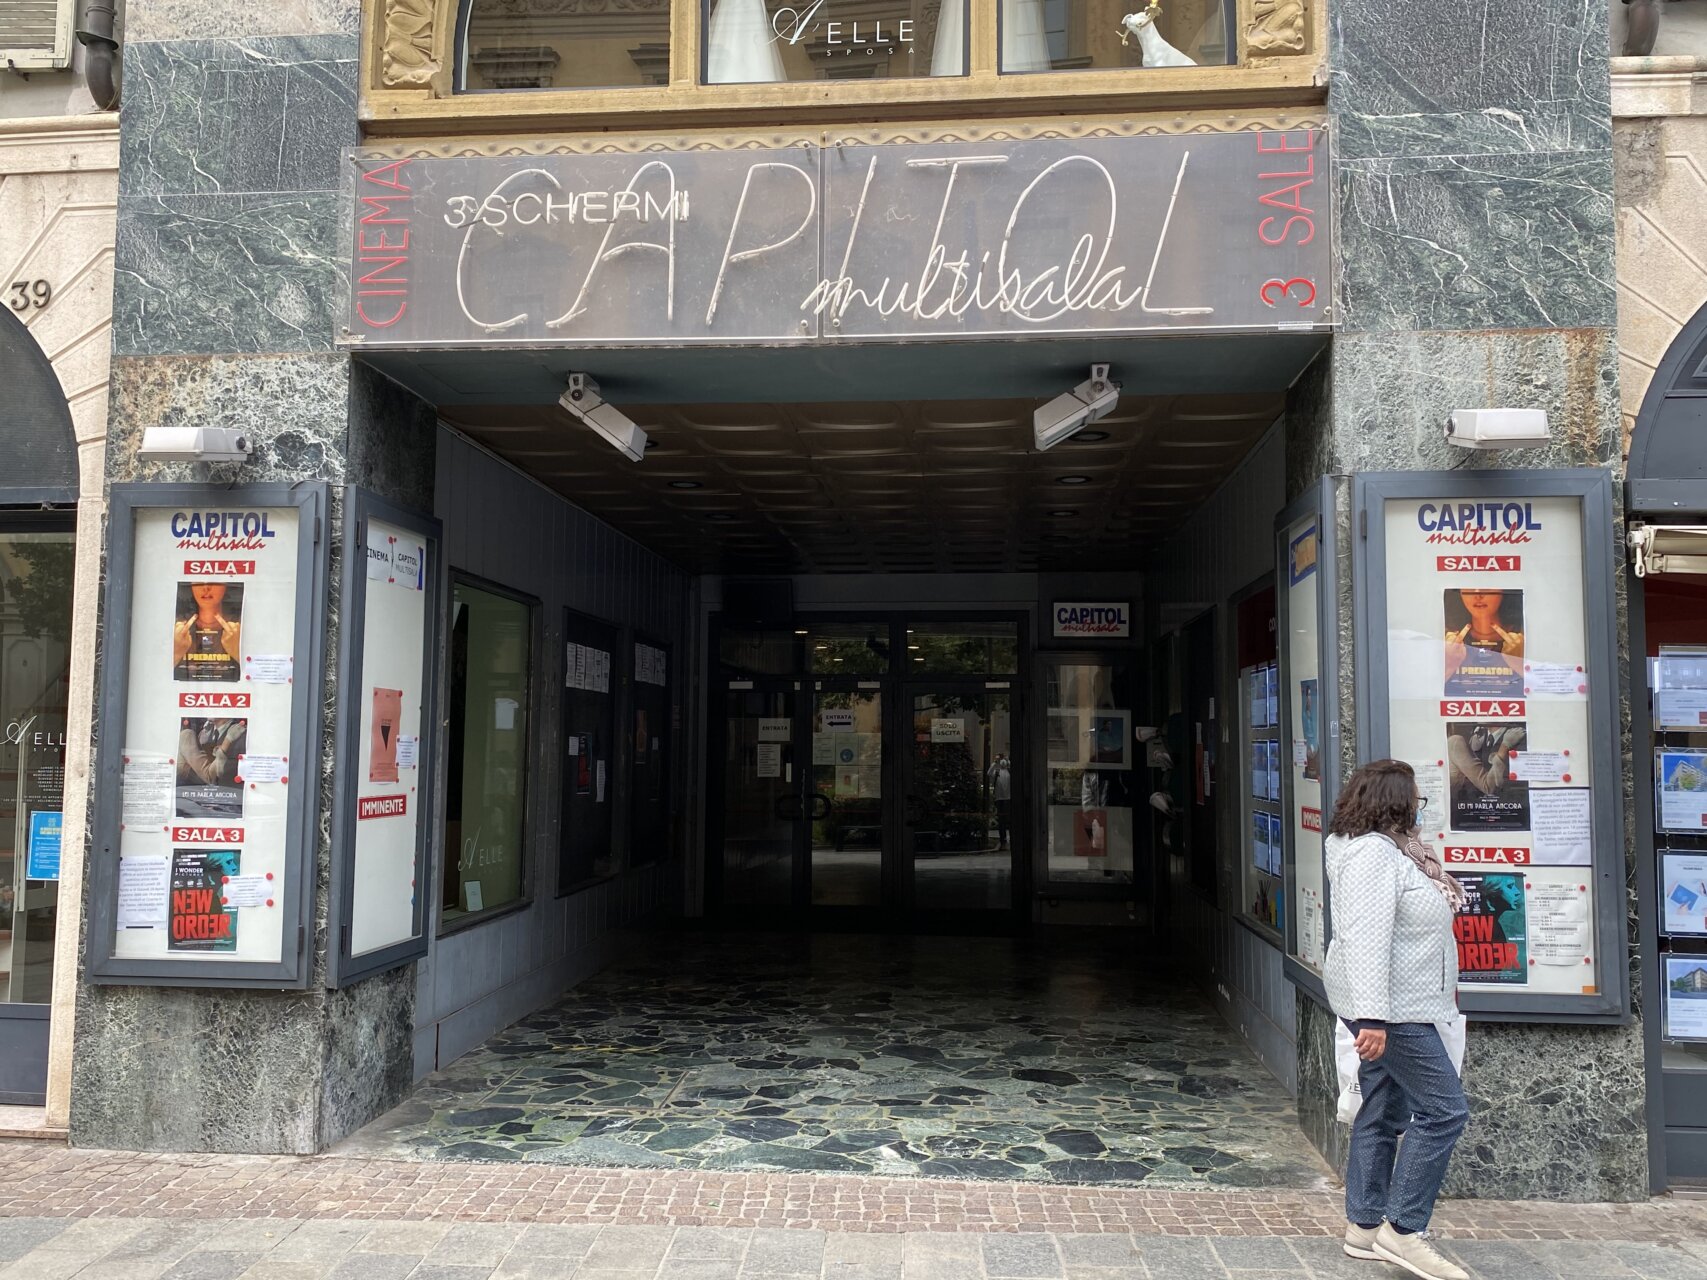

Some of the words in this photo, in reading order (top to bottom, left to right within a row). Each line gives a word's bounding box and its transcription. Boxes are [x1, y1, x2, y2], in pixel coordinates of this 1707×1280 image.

[826, 47, 915, 57] SPOSA
[1257, 129, 1315, 246] SALE
[443, 195, 480, 229] 3
[481, 190, 690, 226] SCHERMI
[357, 158, 413, 328] CINEMA
[456, 151, 1214, 328] CAPITOL
[799, 233, 1146, 318] multisala
[11, 279, 52, 311] 39
[1259, 277, 1316, 308] 3
[171, 512, 275, 538] CAPITOL
[1417, 503, 1542, 532] CAPITOL
[176, 530, 266, 550] multisala
[1425, 522, 1532, 545] multisala
[190, 562, 237, 574] SALA
[242, 562, 250, 573] 1
[398, 553, 417, 566] CAPITOL
[1444, 557, 1500, 570] SALA
[1506, 558, 1515, 569] 1
[1057, 607, 1127, 625] CAPITOL
[1061, 619, 1121, 632] multisala
[184, 694, 231, 707] SALA
[236, 696, 247, 707] 2
[1446, 703, 1503, 716] SALA
[1509, 703, 1520, 715] 2
[0, 715, 67, 745] A'ELL
[361, 798, 404, 816] IMMINENTE
[177, 829, 226, 841] SALA
[230, 829, 240, 841] 3
[1450, 849, 1509, 863] SALA
[1513, 851, 1525, 863] 3
[173, 889, 213, 914] NEW
[173, 914, 231, 939] ORDER
